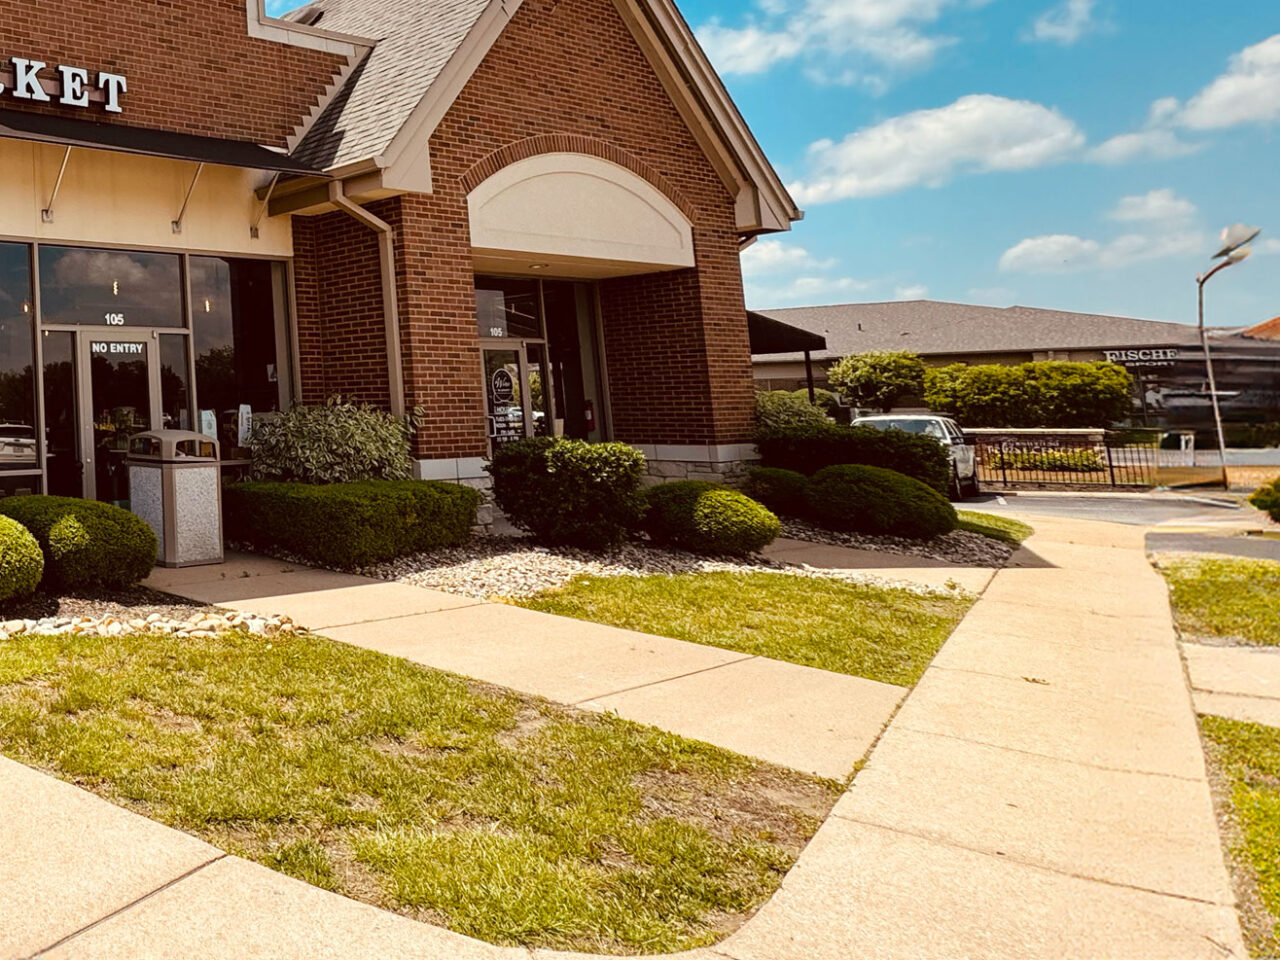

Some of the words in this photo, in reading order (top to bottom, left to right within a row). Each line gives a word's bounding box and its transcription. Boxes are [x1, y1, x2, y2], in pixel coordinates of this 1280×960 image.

[105, 313, 125, 325] 105
[490, 327, 503, 337] 105
[92, 342, 107, 353] NO
[110, 343, 143, 354] ENTRY
